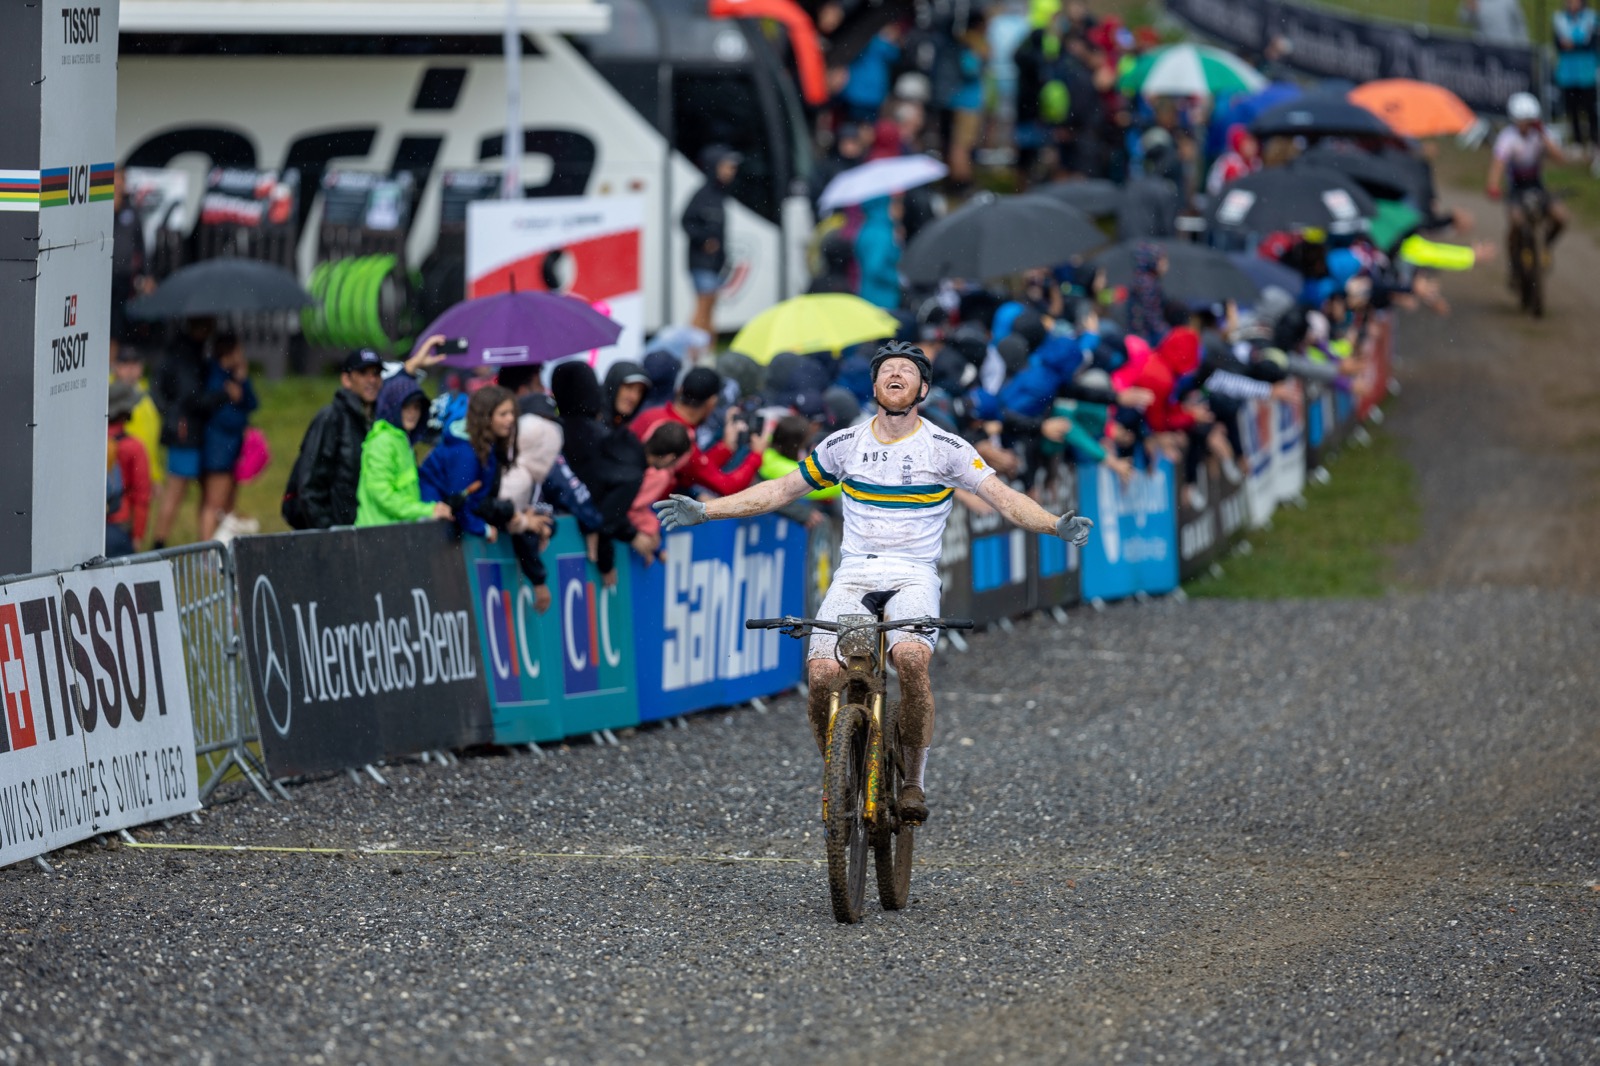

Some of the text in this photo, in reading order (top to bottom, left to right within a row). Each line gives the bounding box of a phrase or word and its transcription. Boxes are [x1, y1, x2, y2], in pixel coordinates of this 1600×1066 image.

[61, 7, 101, 45] TISSOT
[69, 164, 89, 206] UCI
[51, 332, 89, 375] TISSOT
[292, 587, 477, 704] Mercedes-Benz
[486, 585, 541, 680] CIC
[563, 577, 621, 672] CIC
[661, 517, 789, 692] Santini
[20, 580, 167, 741] TISSOT
[0, 745, 187, 849] WISS WATCHES SINCE 1853
